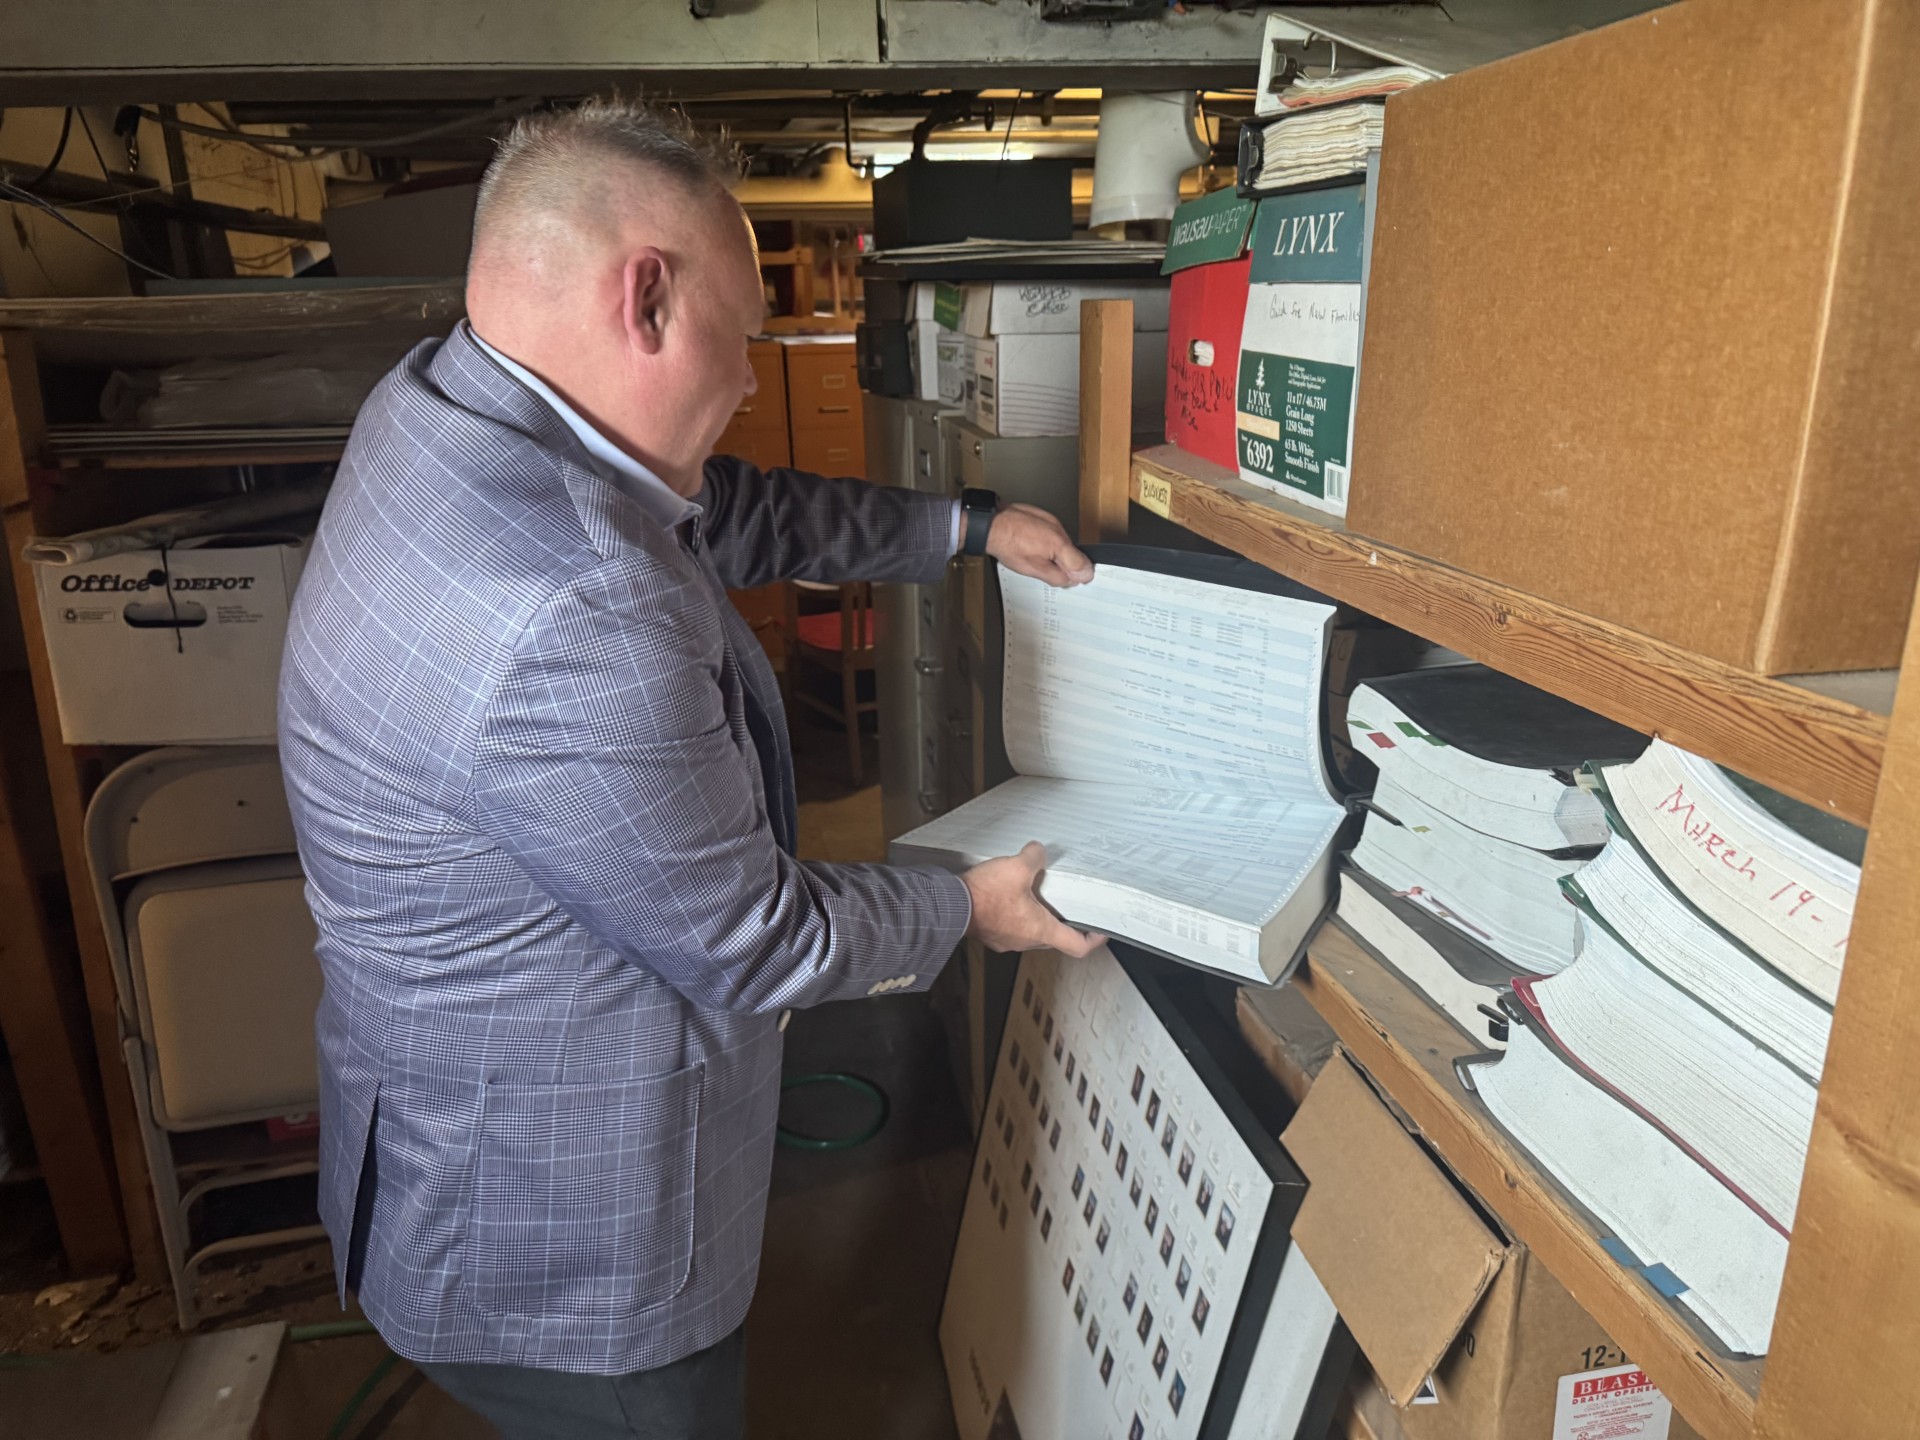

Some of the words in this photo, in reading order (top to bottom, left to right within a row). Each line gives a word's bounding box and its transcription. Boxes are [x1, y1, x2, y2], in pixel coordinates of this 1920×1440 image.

[1273, 211, 1344, 256] LYNX
[1247, 388, 1272, 409] LYNX
[1246, 403, 1273, 417] OPAQUE
[1285, 404, 1301, 418] Grain
[1301, 408, 1315, 426] Long
[1298, 421, 1314, 437] Sheets
[1247, 439, 1274, 474] 6392
[1298, 441, 1315, 457] White
[1284, 451, 1304, 469] Smooth
[1304, 456, 1320, 474] Finish
[60, 573, 150, 592] Office
[172, 576, 255, 591] DEPOT
[1572, 1393, 1608, 1405] DRAIN
